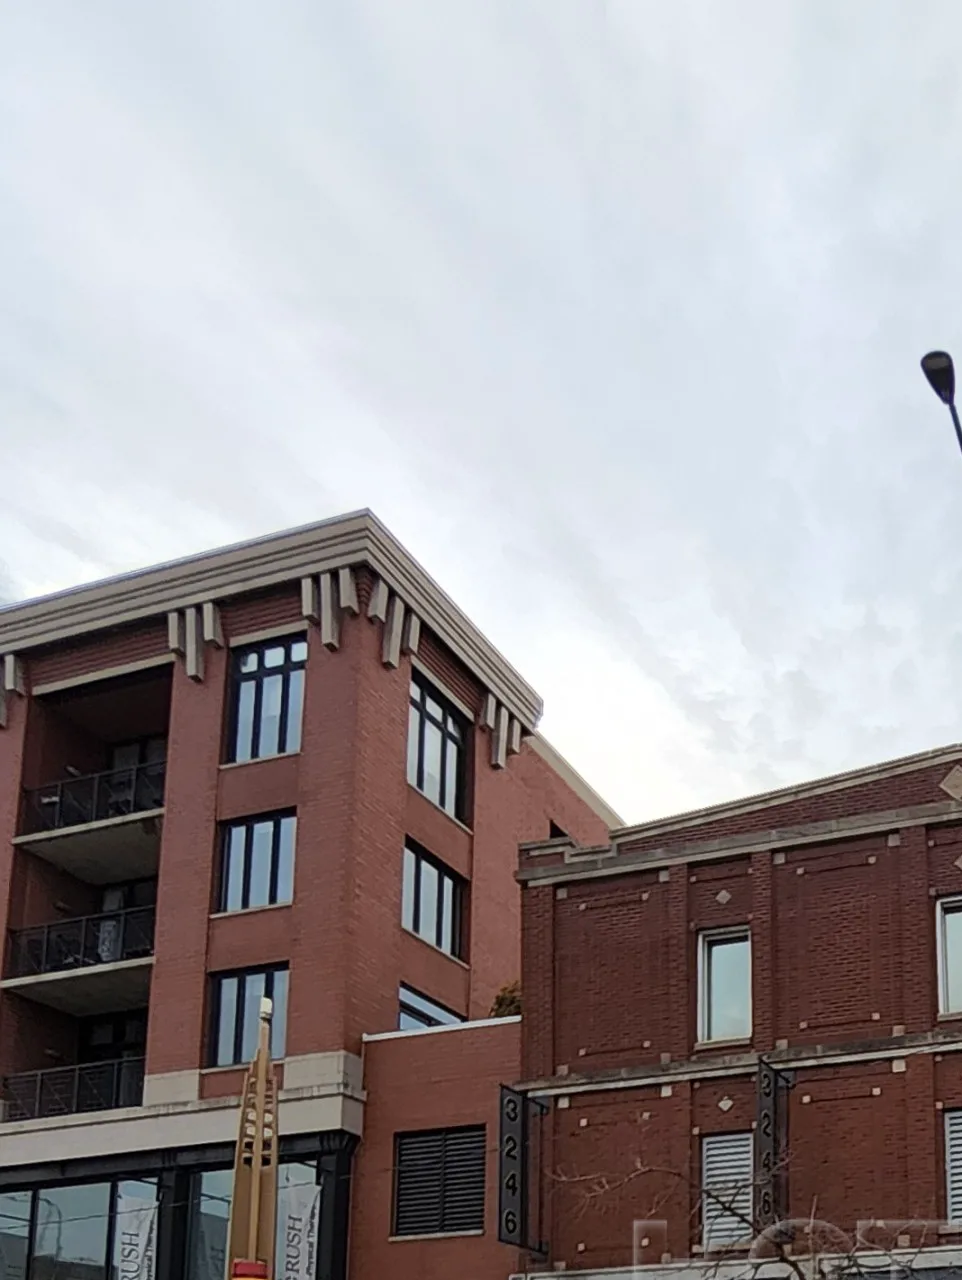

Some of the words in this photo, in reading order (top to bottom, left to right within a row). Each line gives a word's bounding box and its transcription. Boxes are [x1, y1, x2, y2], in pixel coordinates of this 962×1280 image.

[504, 1097, 519, 1235] 3246
[760, 1072, 772, 1216] 3246
[285, 1214, 303, 1275] RUSH
